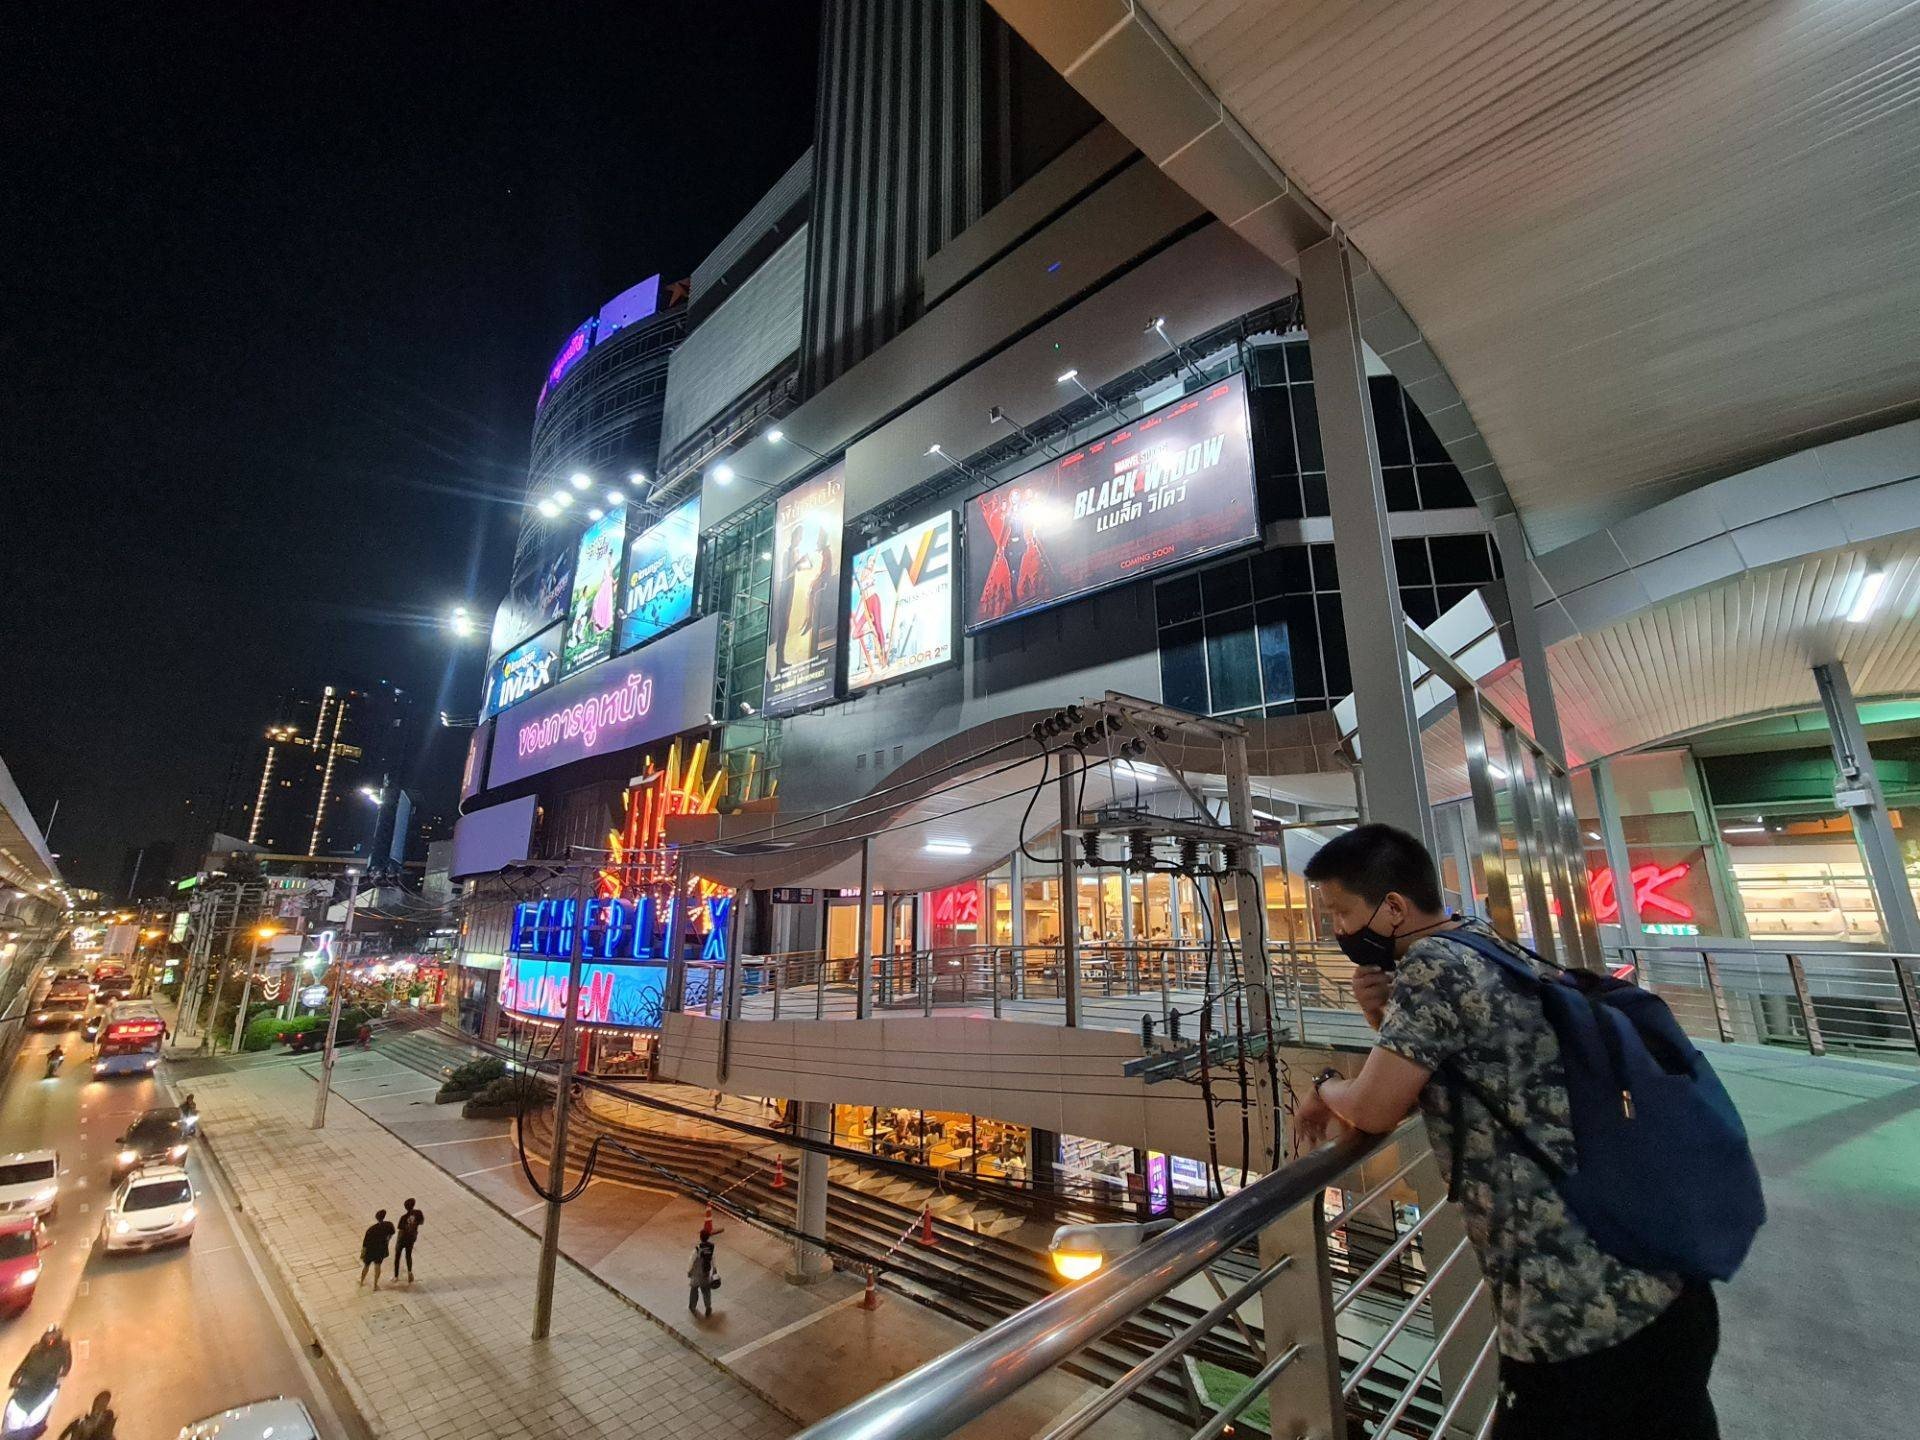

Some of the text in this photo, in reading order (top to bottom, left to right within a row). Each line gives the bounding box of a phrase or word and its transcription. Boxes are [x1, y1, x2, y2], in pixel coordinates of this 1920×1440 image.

[1073, 434, 1225, 520] BLACK WIDOW
[881, 521, 949, 593] WE
[1120, 544, 1176, 569] COMING SOON
[626, 561, 688, 615] IMAX
[498, 655, 551, 708] IMAX
